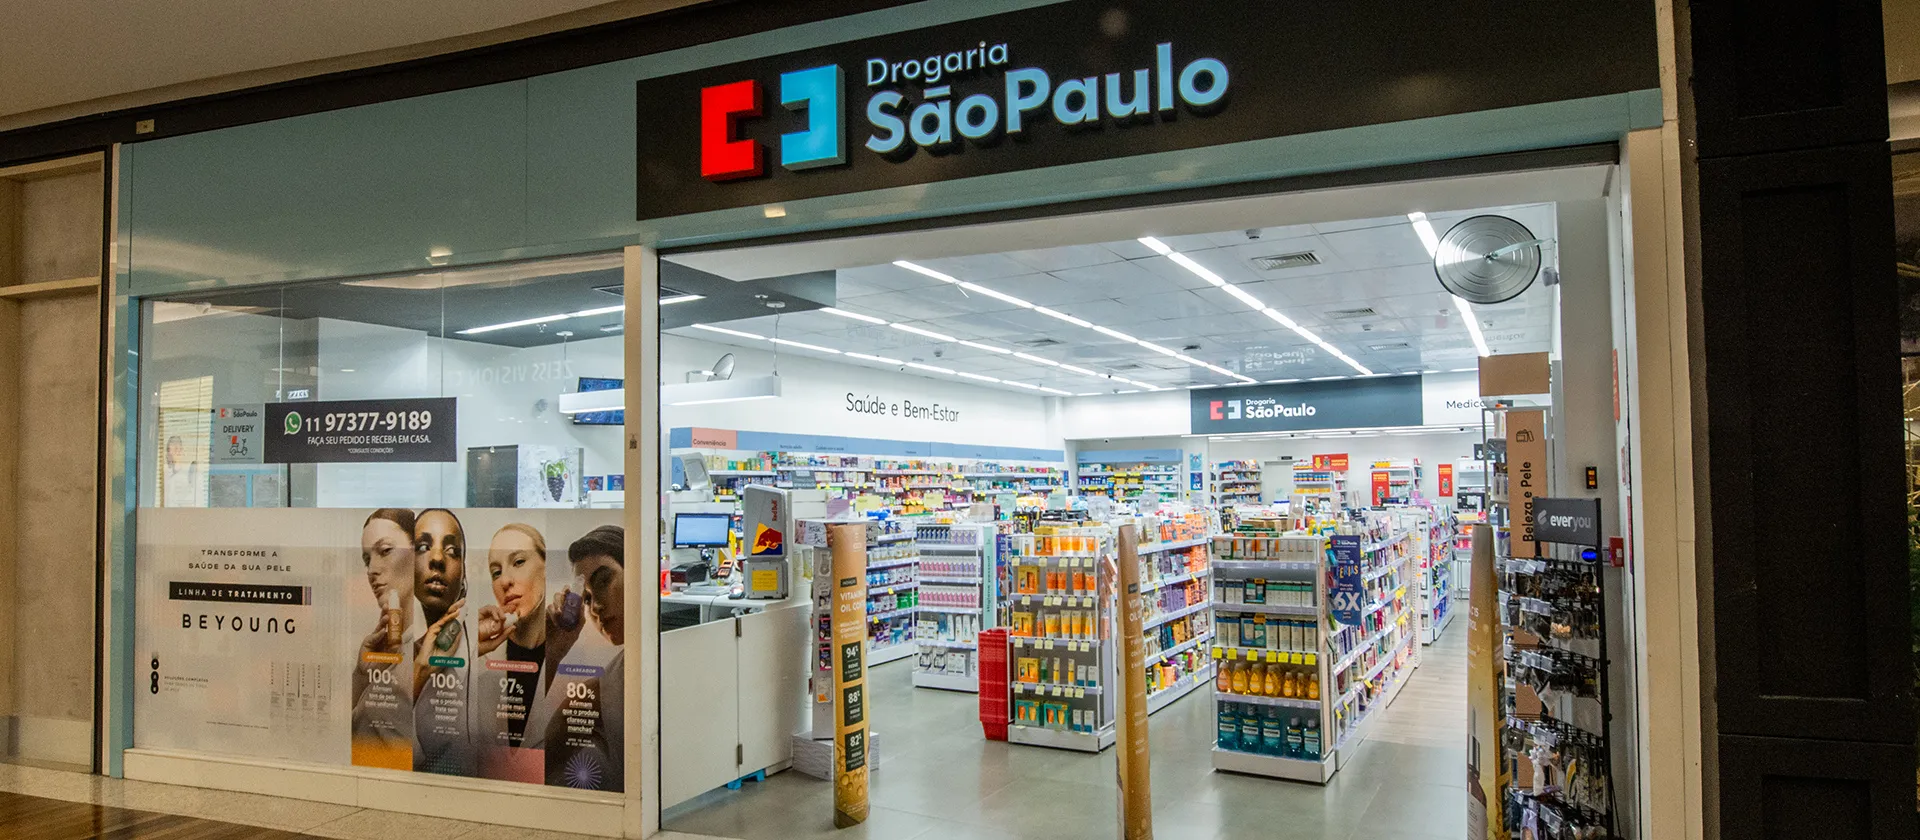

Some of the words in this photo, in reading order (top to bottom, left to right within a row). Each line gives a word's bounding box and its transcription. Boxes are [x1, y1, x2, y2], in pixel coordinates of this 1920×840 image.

[866, 42, 1009, 86] Drogaria
[865, 42, 1229, 153] SãoPaulo
[846, 393, 886, 415] Saúde
[891, 404, 899, 416] e
[904, 400, 959, 422] Bem-Estar
[1246, 398, 1276, 406] Drogaria
[1246, 403, 1316, 419] SãoPaulo
[223, 424, 254, 433] DELIVERY
[305, 417, 320, 432] 11
[325, 411, 432, 432] 97377-9189
[307, 436, 324, 446] FAÇA
[325, 436, 338, 445] SEU
[339, 435, 365, 444] PEDIDO
[366, 436, 370, 444] E
[371, 435, 397, 444] RECEBA
[398, 435, 409, 444] EM
[410, 434, 431, 443] CASA.
[693, 438, 727, 447] Conveniência
[1520, 461, 1532, 487] Pele
[1522, 501, 1534, 541] Beleza
[1549, 515, 1592, 532] everyou
[201, 549, 266, 557] TRANSFORME
[188, 561, 219, 570] SAÚDE
[178, 588, 207, 596] LINHA
[211, 589, 222, 597] DE
[228, 590, 293, 600] TRATAMENTO
[1334, 591, 1361, 611] 6X
[182, 613, 296, 634] BEYOUNG
[367, 668, 398, 685] 100%
[430, 673, 464, 690] 100%
[499, 677, 524, 694] 97%
[566, 682, 595, 699] 80%
